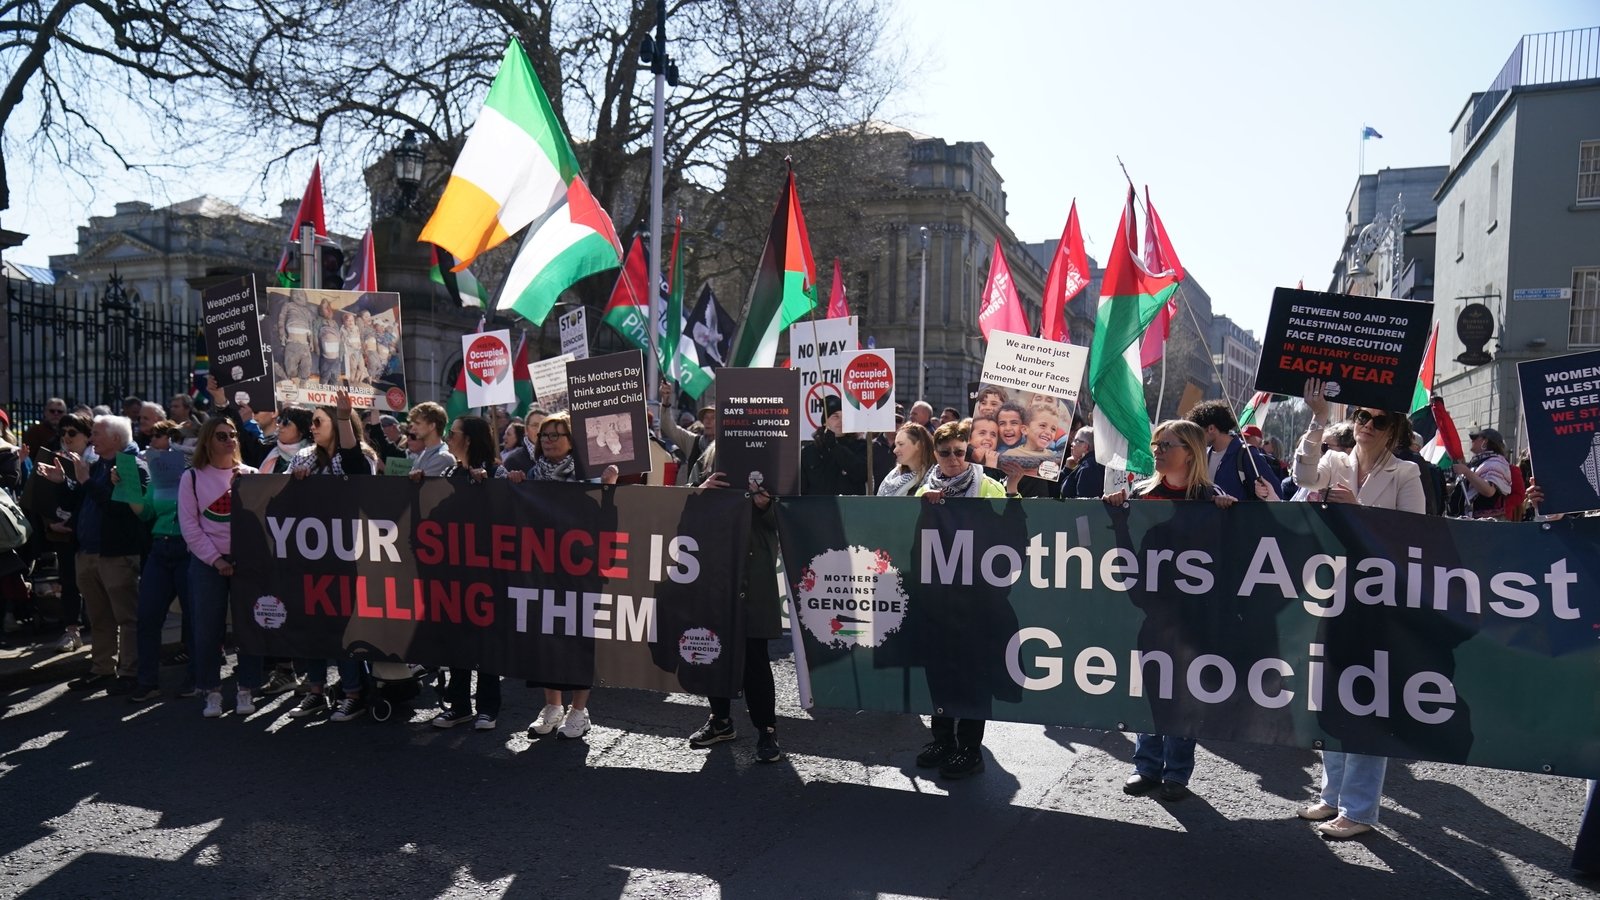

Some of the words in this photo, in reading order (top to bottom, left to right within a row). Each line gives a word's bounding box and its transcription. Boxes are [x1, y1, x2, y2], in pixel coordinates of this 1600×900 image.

[206, 292, 241, 309] Weapons
[241, 287, 250, 298] of
[205, 307, 240, 324] Genocide
[241, 303, 254, 313] are
[1291, 305, 1340, 318] BETWEEN
[1342, 311, 1361, 320] 500
[1363, 314, 1386, 324] AND
[1389, 316, 1408, 326] 700
[217, 320, 246, 337] passing
[1288, 317, 1352, 332] PALESTINIAN
[1354, 325, 1406, 339] CHILDREN
[218, 333, 247, 350] through
[562, 333, 584, 348] GENOCIDE
[1006, 339, 1020, 348] We
[1037, 346, 1052, 355] not
[1052, 348, 1070, 358] just
[1285, 329, 1315, 341] FACE
[1317, 333, 1403, 352] PROSECUTION
[217, 348, 250, 364] Shannon
[470, 346, 504, 359] Occupied
[798, 343, 814, 359] NO
[818, 340, 847, 356] WAY
[1283, 342, 1295, 351] IN
[1300, 345, 1351, 359] MILITARY
[1353, 352, 1399, 366] COURTS
[468, 358, 508, 370] Territories
[1015, 353, 1055, 367] Numbers
[482, 367, 495, 378] Bill
[569, 374, 586, 385] This
[587, 370, 622, 382] Mothers
[623, 367, 641, 377] Day
[802, 371, 817, 386] TO
[848, 368, 887, 380] Occupied
[995, 362, 1016, 372] Look
[1018, 367, 1027, 375] at
[1028, 370, 1043, 378] our
[1045, 371, 1070, 383] Faces
[1279, 355, 1334, 376] EACH
[1340, 363, 1395, 385] YEAR
[306, 382, 348, 393] PALESTINIAN
[349, 386, 375, 395] BABIES
[573, 386, 595, 398] think
[595, 383, 621, 394] about
[622, 380, 638, 390] this
[847, 380, 890, 390] Territories
[983, 371, 1029, 387] Remember
[1047, 384, 1077, 397] Names
[307, 392, 327, 402] NOT
[350, 396, 376, 407] RGET
[571, 399, 601, 411] Mother
[602, 396, 619, 407] and
[620, 392, 643, 404] Child
[861, 390, 875, 400] Bill
[1541, 398, 1566, 410] WE
[1569, 393, 1600, 407] SEE
[1551, 410, 1575, 422] WE
[1554, 422, 1595, 436] WITH
[266, 516, 402, 563] YOUR
[416, 520, 630, 580] SILENCE
[648, 534, 701, 585] IS
[824, 574, 879, 583] MOTHERS
[920, 528, 1215, 595] Mothers
[1236, 536, 1581, 620] Against
[826, 586, 877, 595] AGAINST
[303, 574, 495, 628] KILLING
[507, 586, 658, 643] THEM
[807, 598, 901, 613] GENOCIDE
[1004, 626, 1457, 725] Genocide
